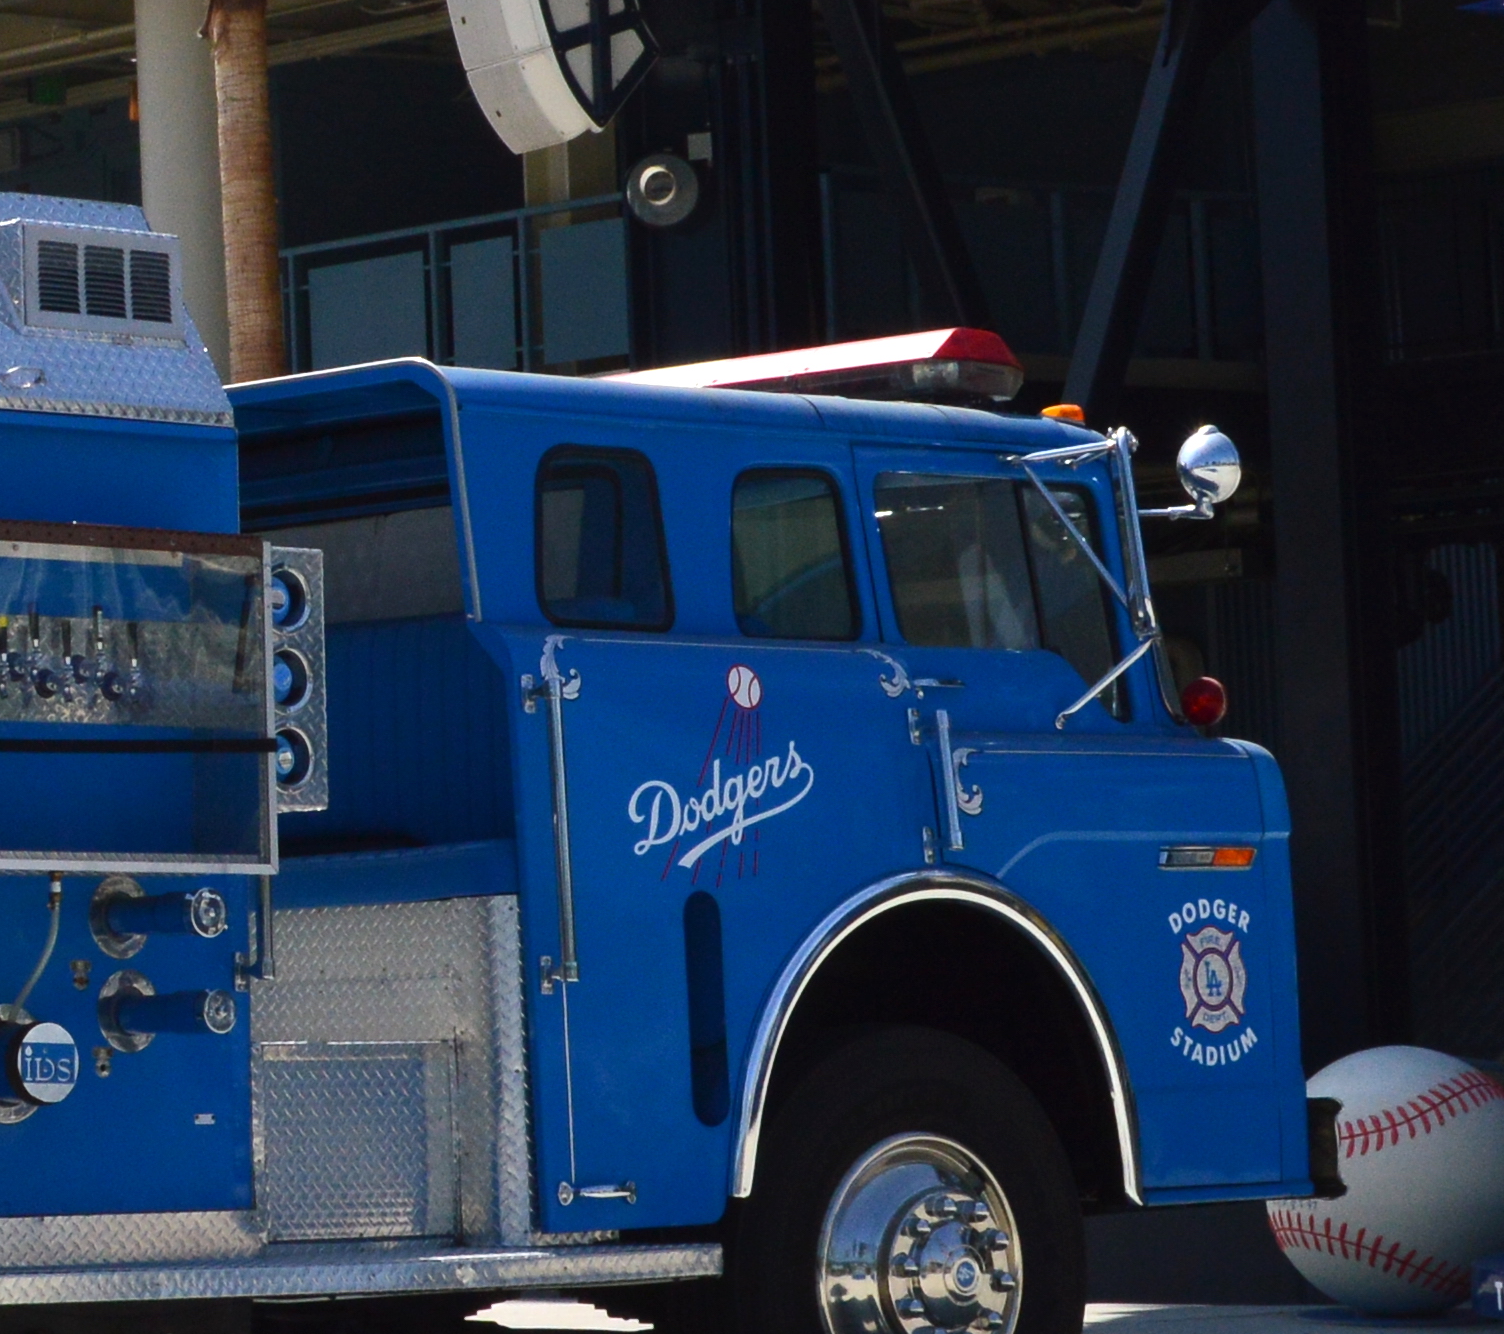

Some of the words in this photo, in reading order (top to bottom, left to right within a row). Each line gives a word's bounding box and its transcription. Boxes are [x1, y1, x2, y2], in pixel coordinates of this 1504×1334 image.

[629, 741, 814, 868] Dodgers
[1168, 899, 1250, 934] DODGER
[1204, 960, 1222, 997] LA
[1170, 1026, 1258, 1066] STADIUM
